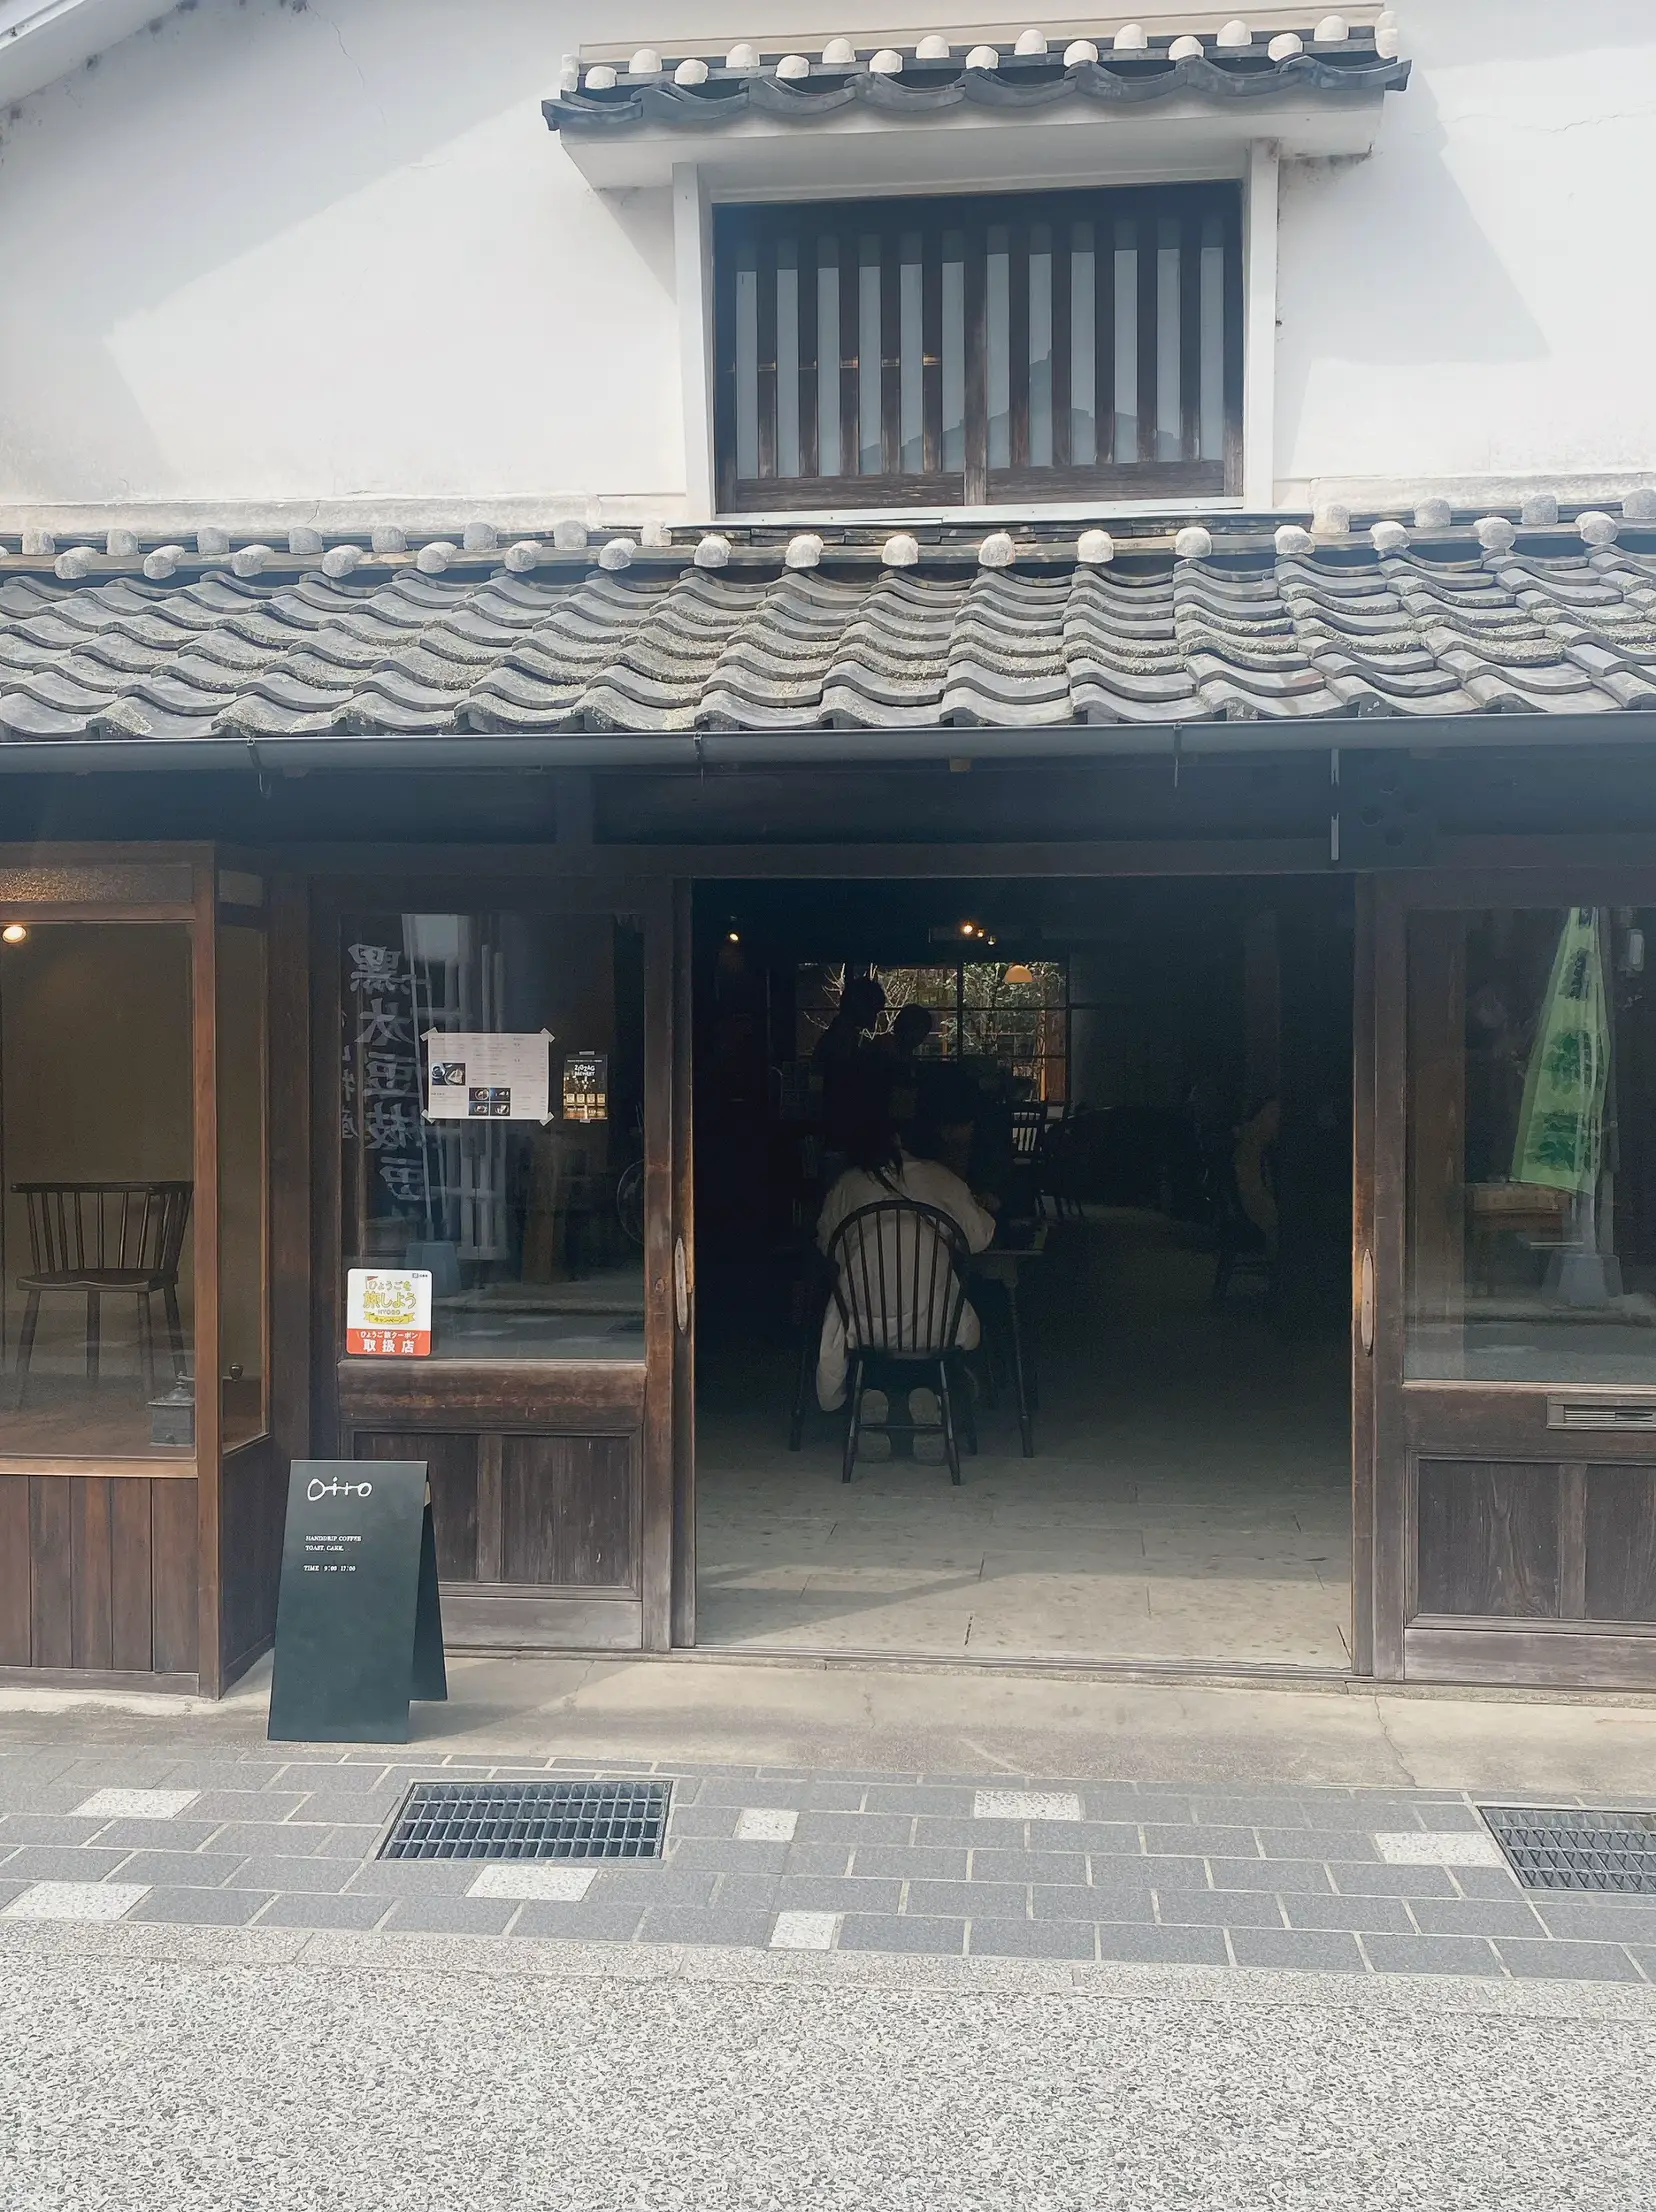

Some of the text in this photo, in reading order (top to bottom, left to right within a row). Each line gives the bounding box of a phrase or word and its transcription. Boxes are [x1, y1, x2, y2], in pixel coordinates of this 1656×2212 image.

[368, 1280, 411, 1291] ひょうごを
[363, 1291, 416, 1309] 旅しよう
[360, 1331, 418, 1339] ひょうご旅クーポン
[363, 1339, 414, 1353] 取扱店
